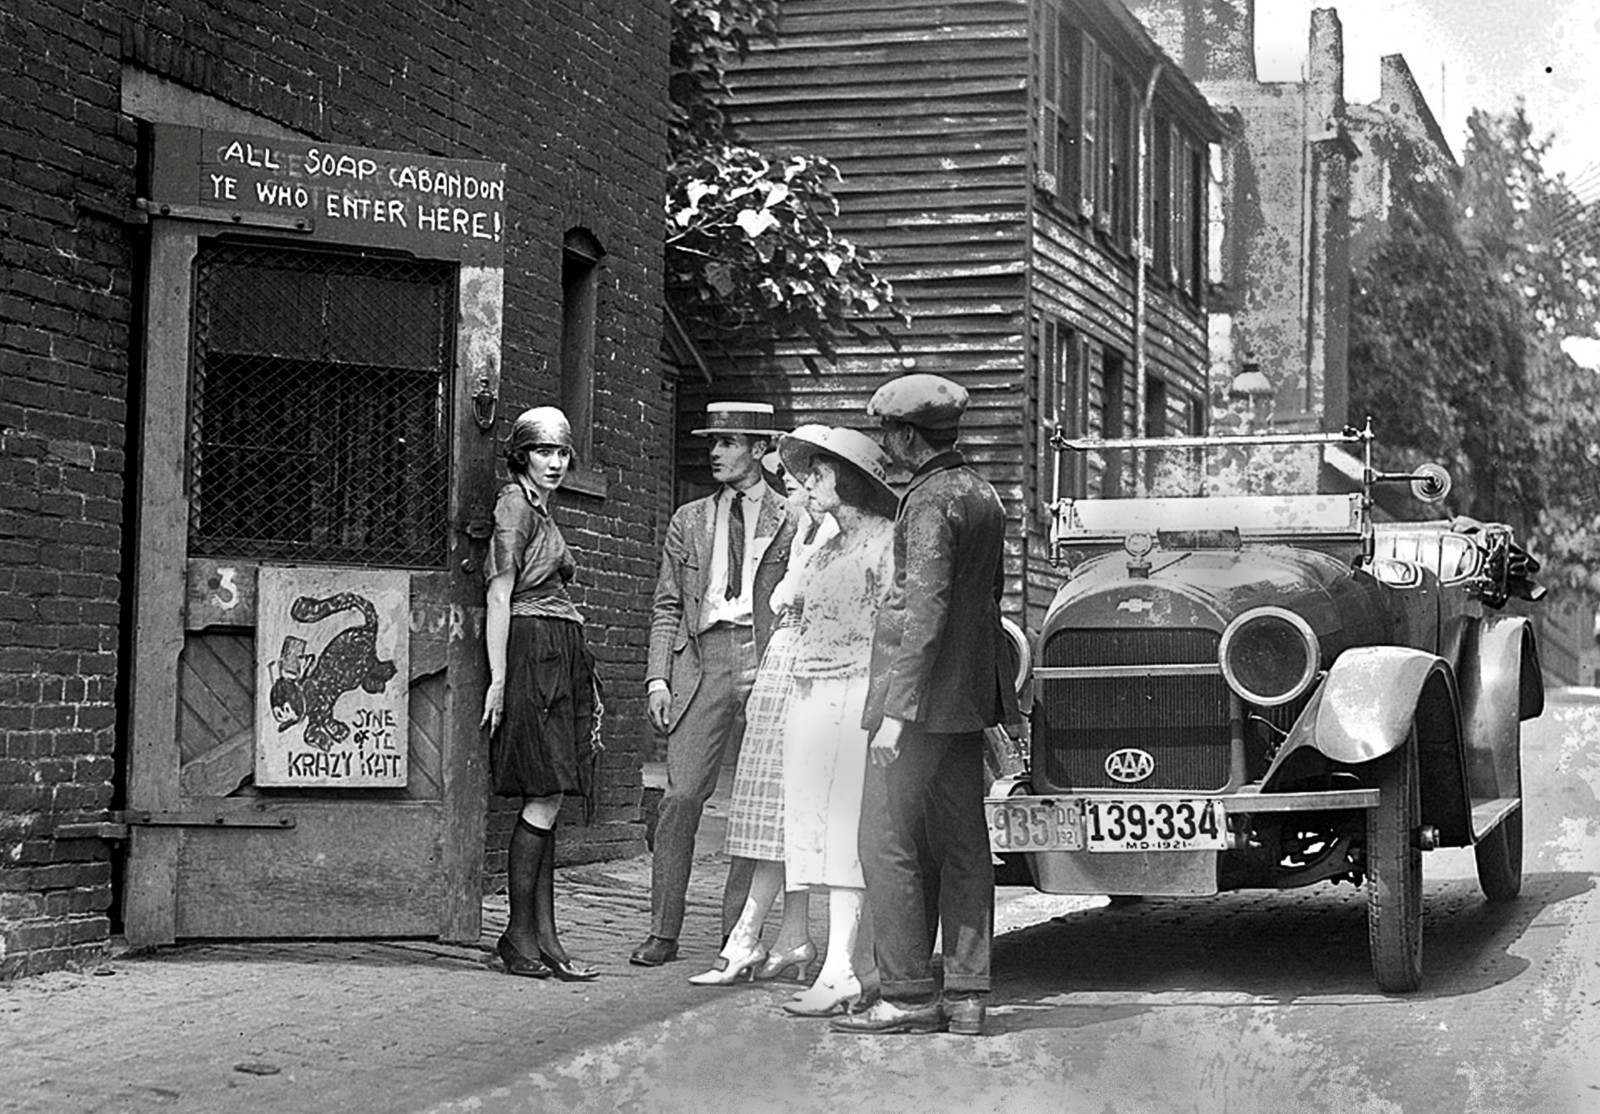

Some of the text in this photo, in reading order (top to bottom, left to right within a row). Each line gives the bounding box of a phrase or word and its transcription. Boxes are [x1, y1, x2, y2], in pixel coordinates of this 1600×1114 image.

[224, 141, 280, 169] ALL
[304, 148, 377, 180] SOAP
[210, 173, 238, 200] YE
[255, 182, 308, 208] WHO
[326, 194, 407, 228] ENTER
[418, 204, 500, 242] HERE!
[211, 567, 239, 609] 3
[288, 751, 353, 778] KRAZY
[1109, 751, 1150, 780] AAA
[1056, 807, 1077, 826] DC
